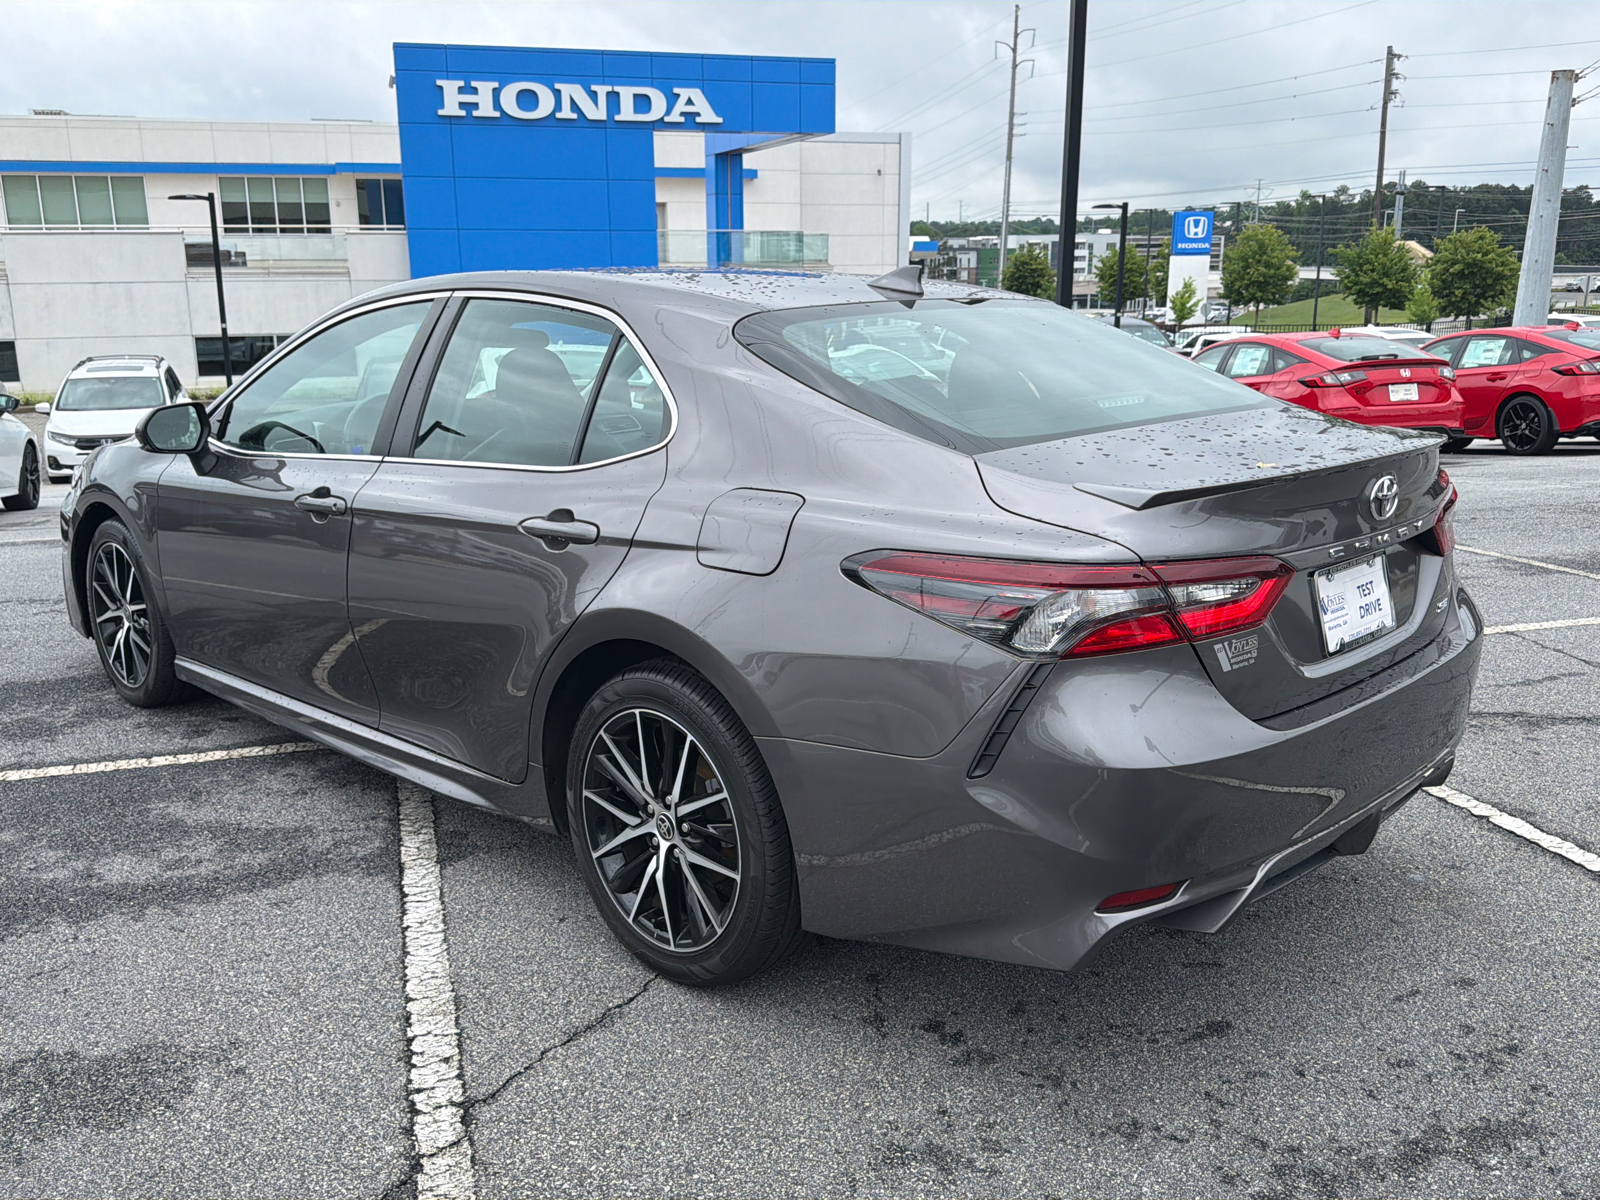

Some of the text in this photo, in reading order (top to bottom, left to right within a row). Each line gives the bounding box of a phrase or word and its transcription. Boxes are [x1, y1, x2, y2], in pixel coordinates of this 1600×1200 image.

[436, 79, 723, 123] HONDA
[1329, 520, 1423, 556] CAMRY
[1356, 580, 1375, 599] TEST
[1358, 598, 1383, 619] DRIVE
[1216, 646, 1224, 654] ED
[1223, 637, 1258, 659] VOYLES
[1230, 653, 1251, 664] HONDA
